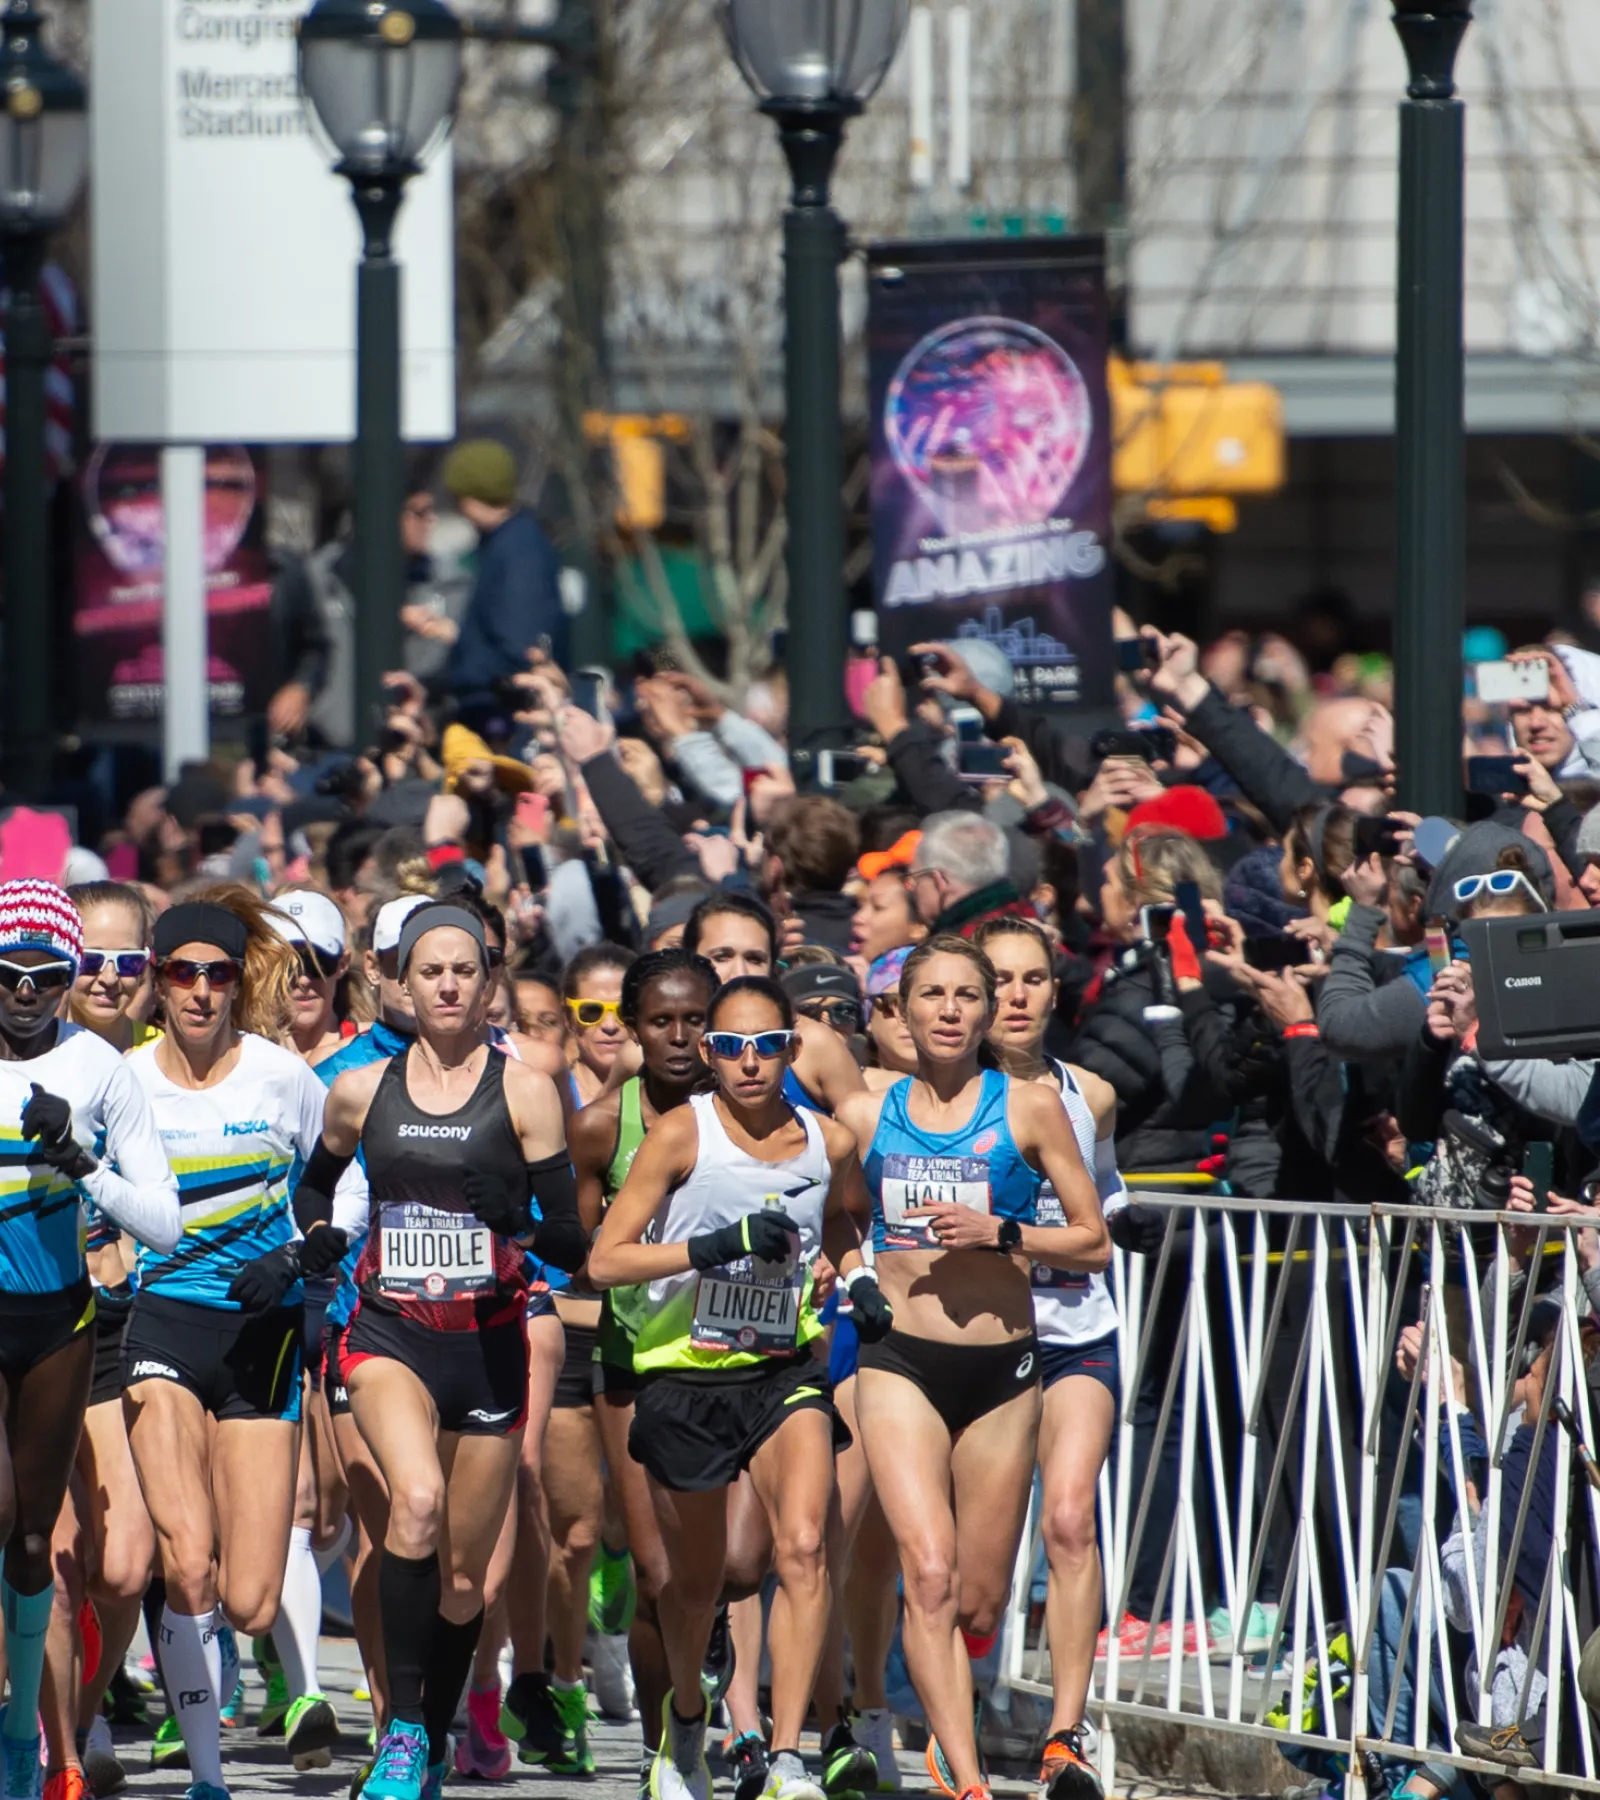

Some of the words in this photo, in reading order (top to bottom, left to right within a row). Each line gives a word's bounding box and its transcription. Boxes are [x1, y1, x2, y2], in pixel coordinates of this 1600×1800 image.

[883, 531, 1105, 607] AMAZING
[1032, 667, 1079, 685] PARK
[1504, 976, 1542, 988] Canon
[223, 1120, 269, 1137] HOKA
[398, 1123, 472, 1141] saucony
[908, 1157, 924, 1170] U.S.
[933, 1170, 962, 1182] TRIALS
[405, 1217, 428, 1229] TEAM
[432, 1217, 464, 1229] TRIALS
[388, 1231, 484, 1267] HUDDLE
[708, 1282, 791, 1325] LINDEN
[132, 1360, 179, 1378] HOKA
